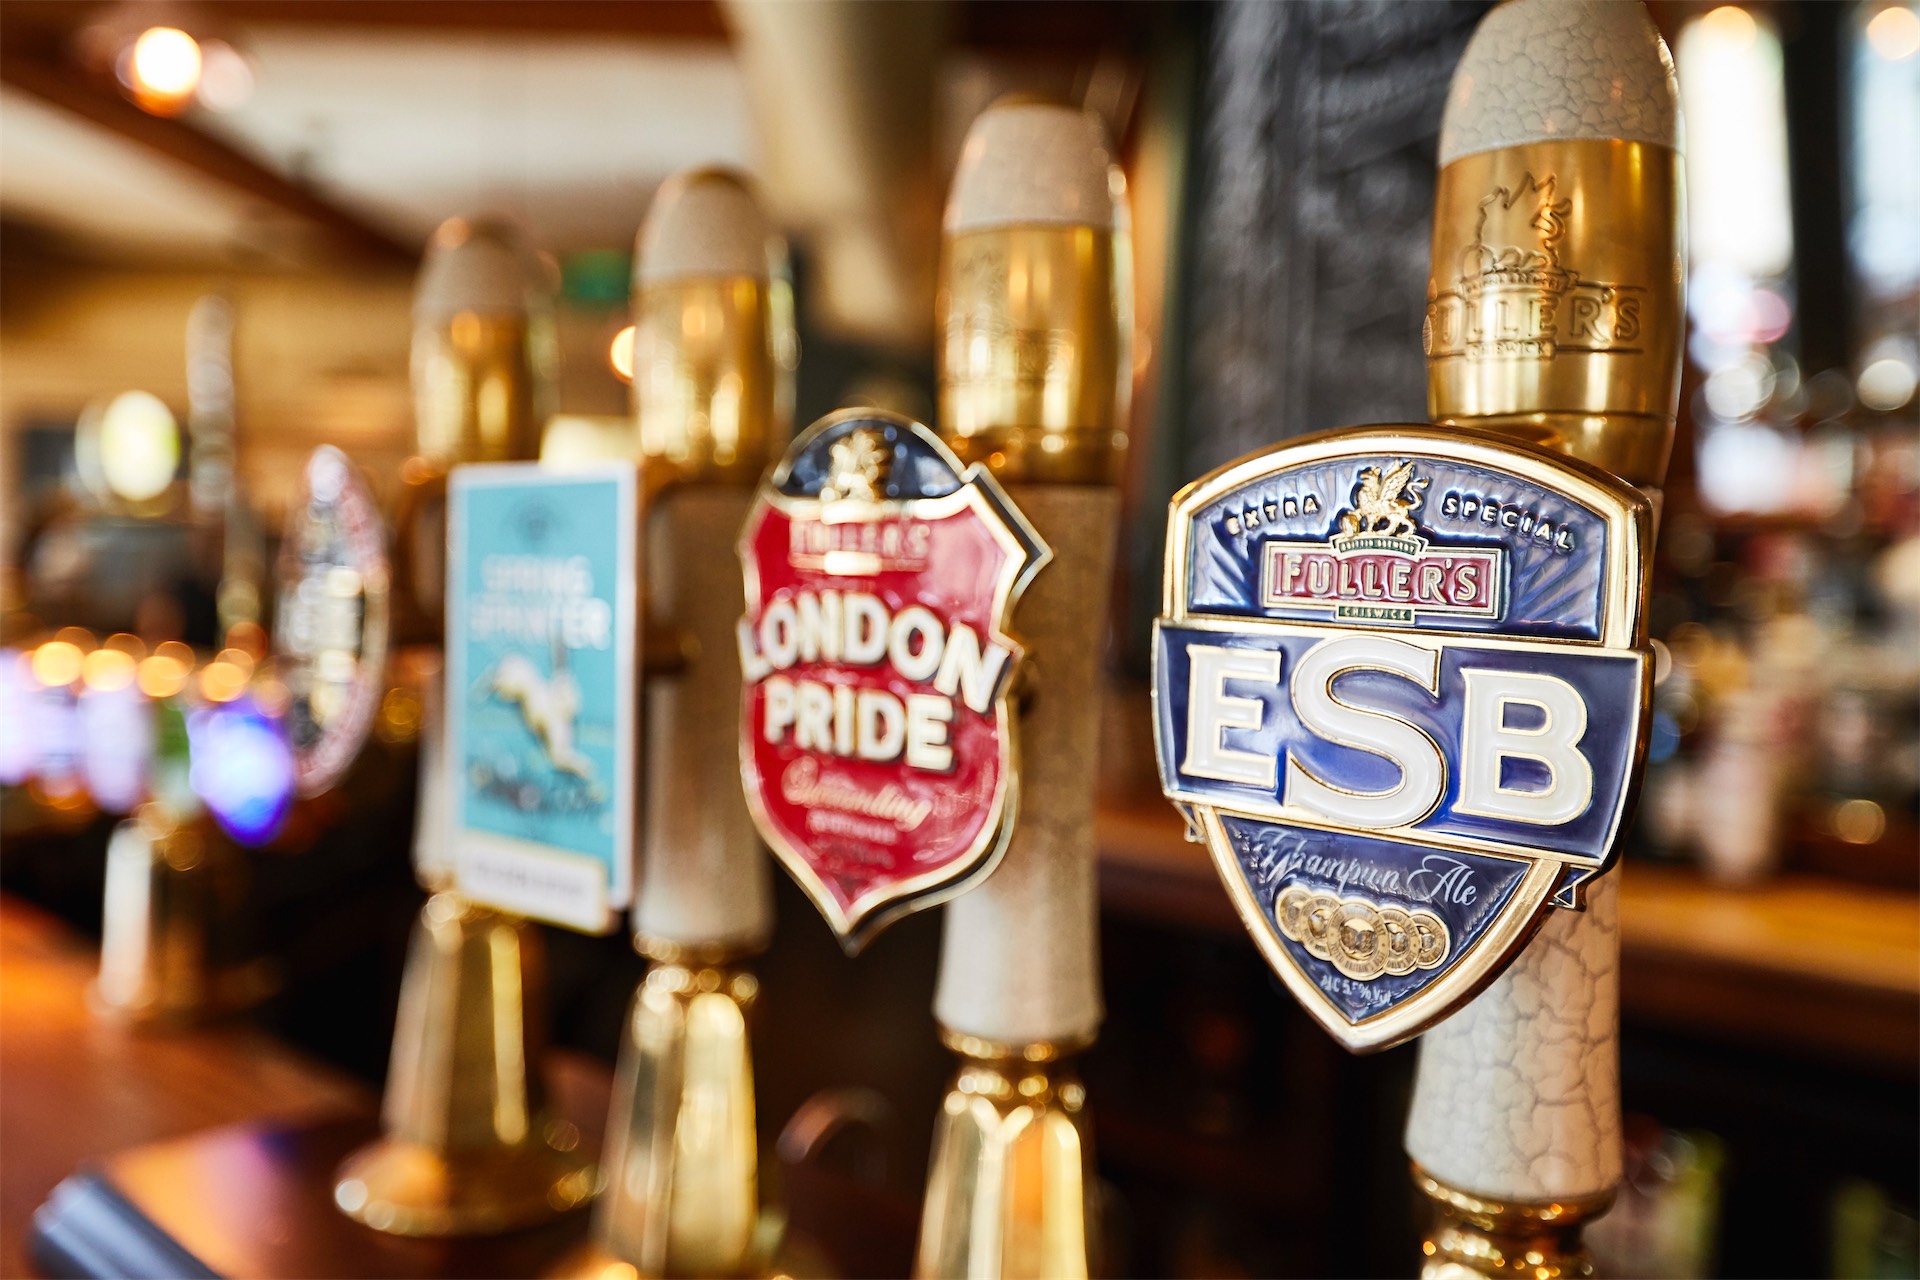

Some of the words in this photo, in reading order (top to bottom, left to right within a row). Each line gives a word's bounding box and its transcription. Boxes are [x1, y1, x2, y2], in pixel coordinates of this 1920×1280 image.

[1226, 497, 1319, 535] EXTRA
[1445, 497, 1573, 550] SPECIAL
[1284, 553, 1479, 603] FULLER'S
[1343, 605, 1407, 620] CHISWICK
[735, 587, 1011, 713] LONDON
[763, 674, 953, 771] PRIDE
[1180, 635, 1594, 830] ESB
[1256, 826, 1401, 894] Champion
[1407, 854, 1478, 906] Ale
